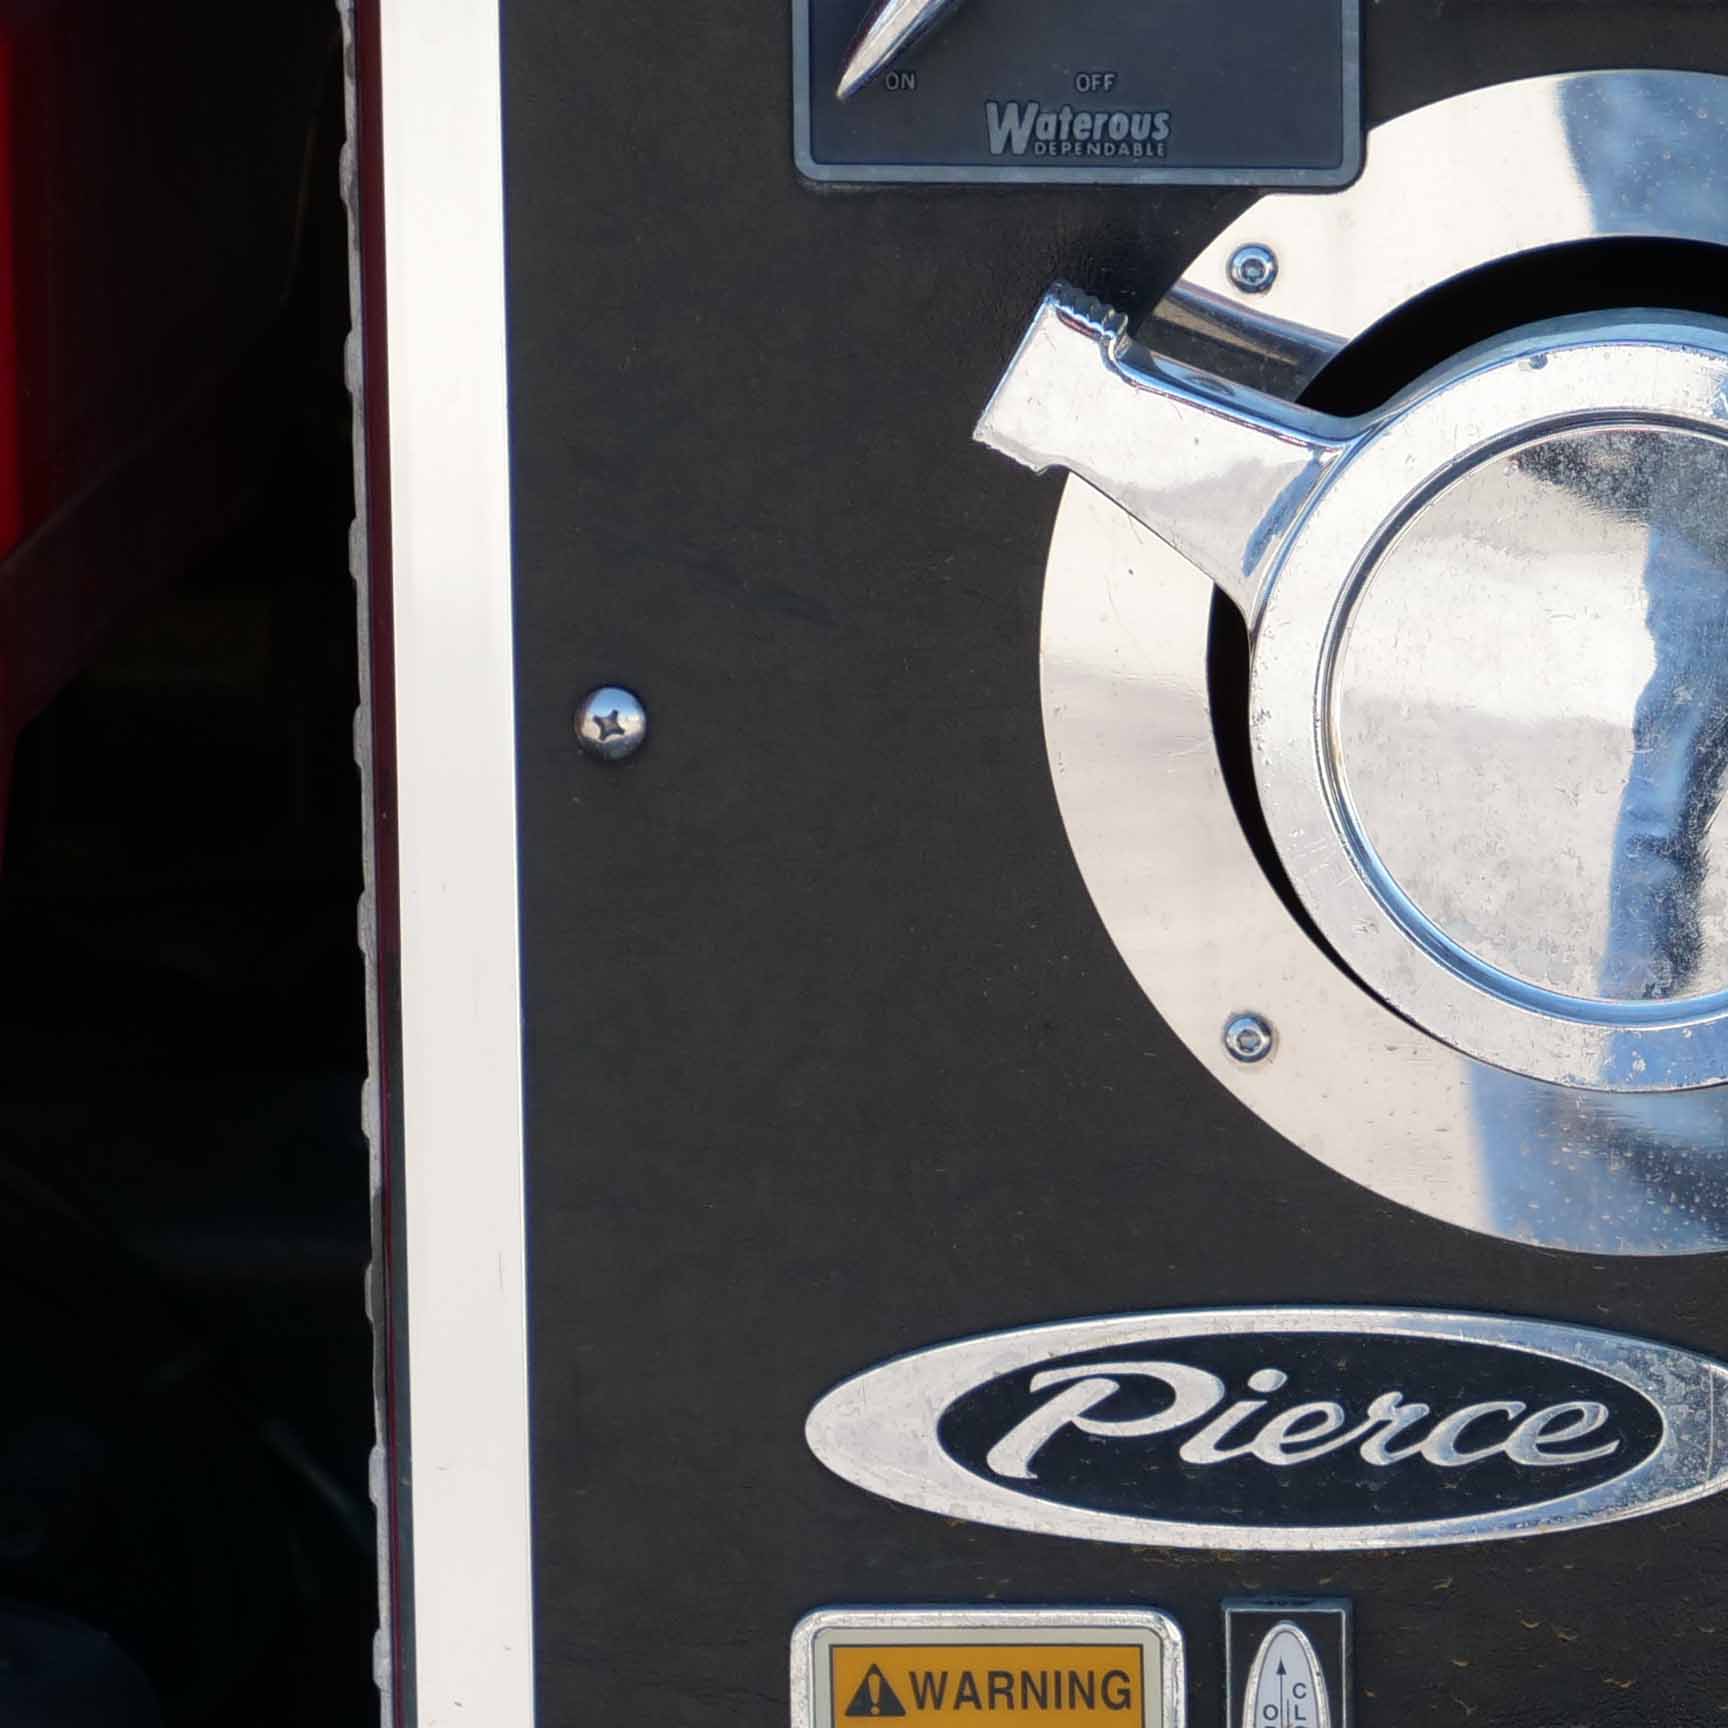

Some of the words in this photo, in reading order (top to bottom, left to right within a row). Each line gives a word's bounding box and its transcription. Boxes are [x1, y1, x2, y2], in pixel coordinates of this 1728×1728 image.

[885, 72, 917, 92] ON
[1075, 72, 1117, 93] OFF
[986, 101, 1171, 155] Waterous
[1034, 139, 1167, 156] DEPENDABLE
[985, 1360, 1621, 1480] Pierce
[908, 1670, 1132, 1711] WARNING
